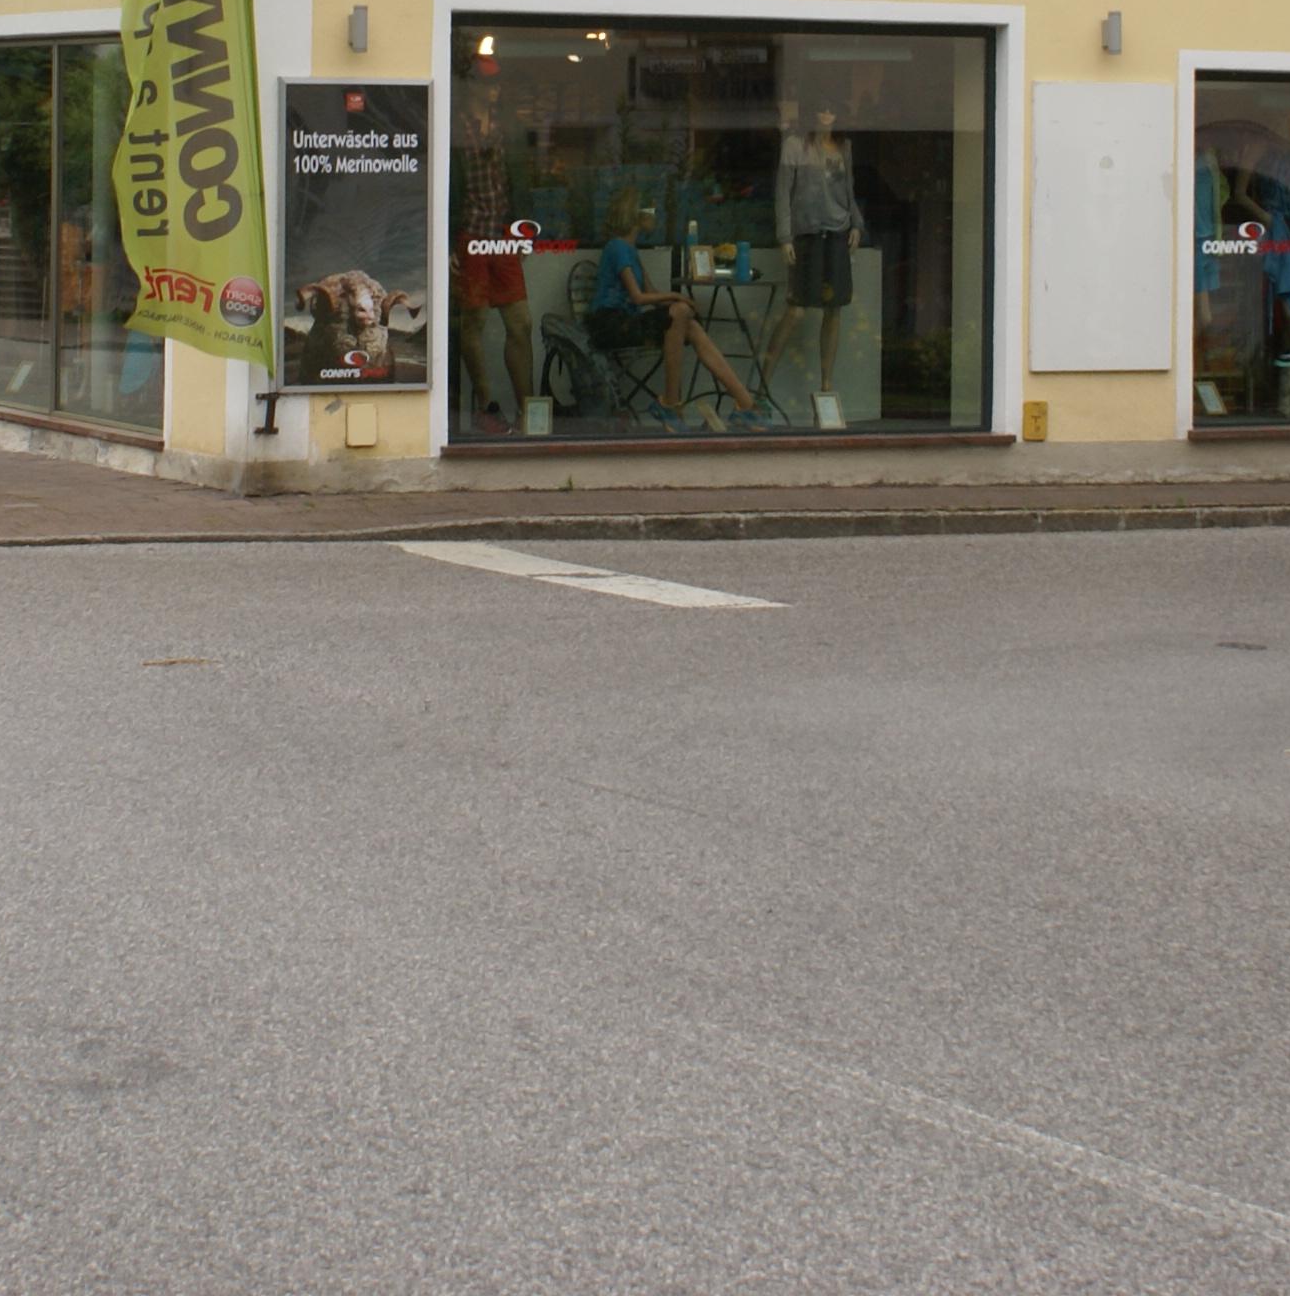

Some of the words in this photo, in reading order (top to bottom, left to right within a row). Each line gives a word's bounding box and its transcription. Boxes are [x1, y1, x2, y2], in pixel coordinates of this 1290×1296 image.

[293, 129, 389, 149] Unterwäsche
[392, 133, 419, 148] aus
[293, 154, 332, 173] 100%
[335, 154, 419, 174] Merinowolle
[467, 239, 533, 255] CONNY'S
[1201, 239, 1258, 255] CONNY'S
